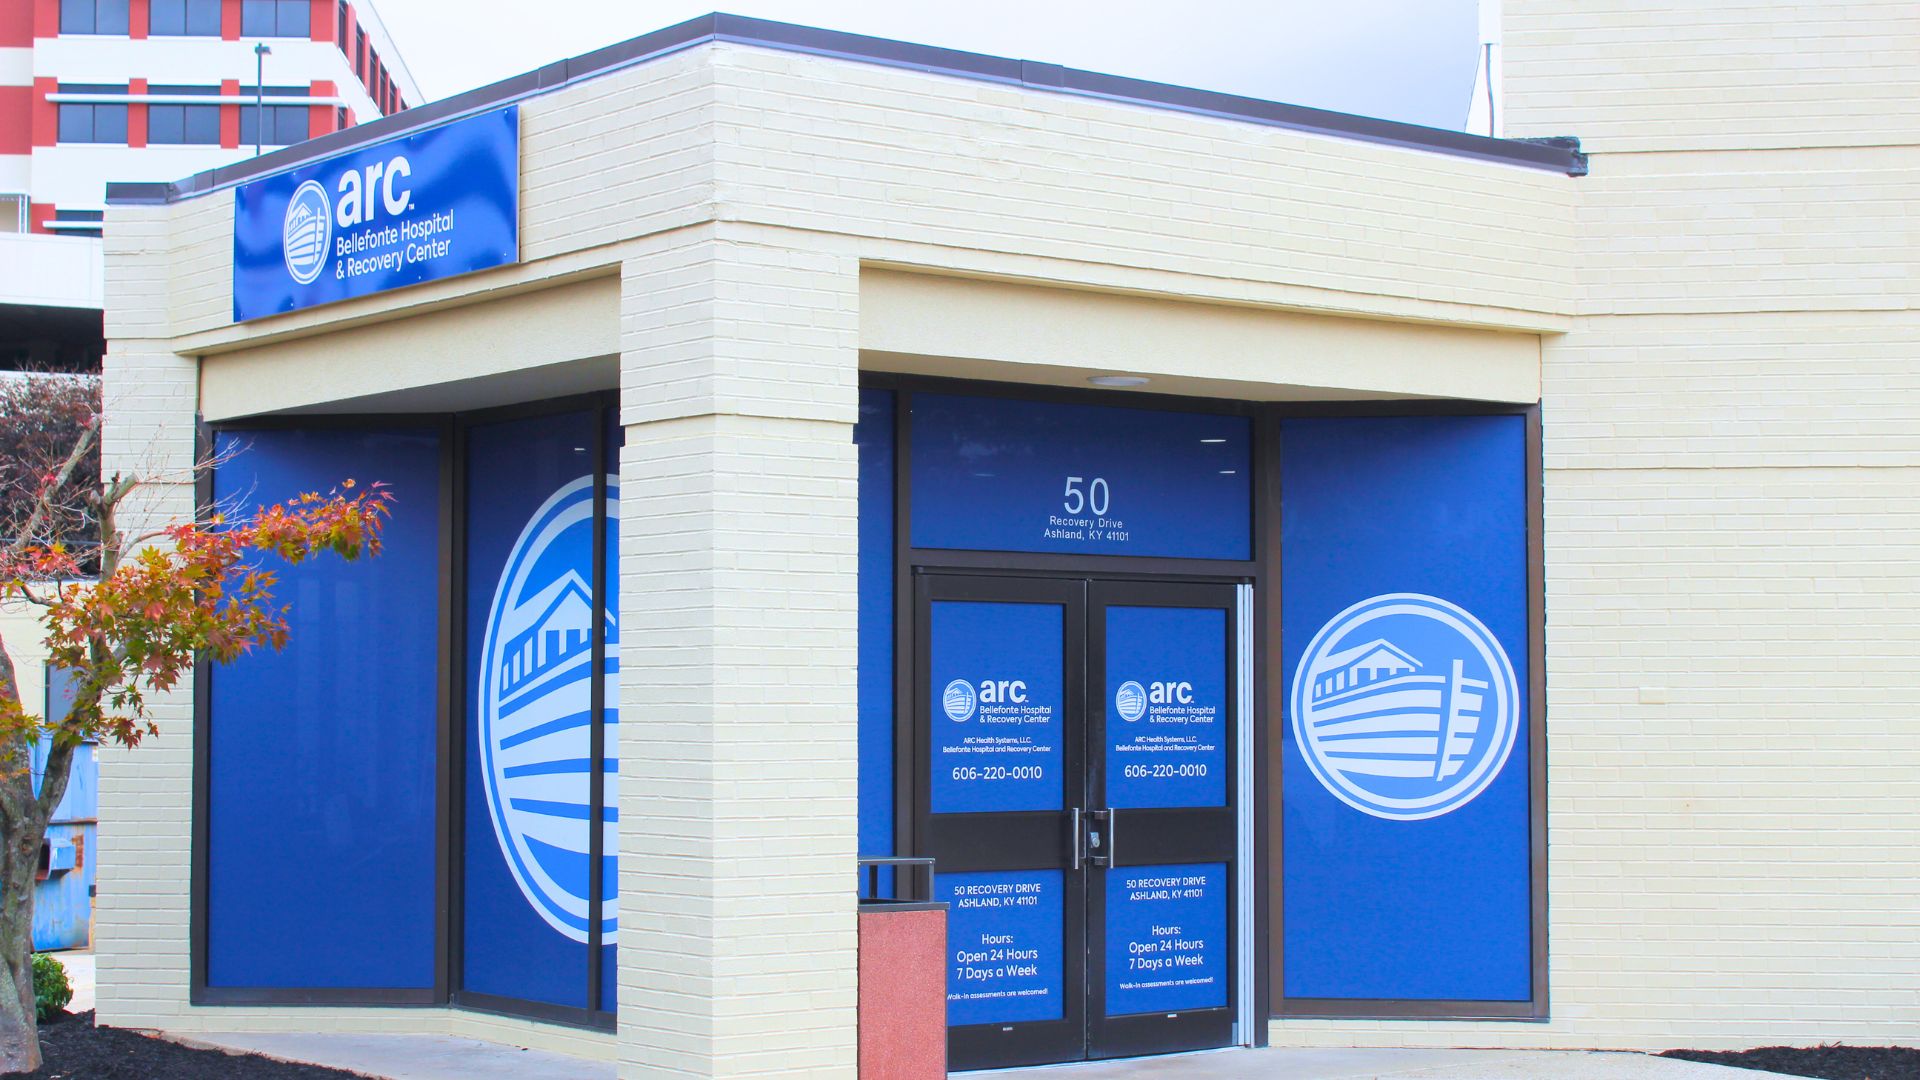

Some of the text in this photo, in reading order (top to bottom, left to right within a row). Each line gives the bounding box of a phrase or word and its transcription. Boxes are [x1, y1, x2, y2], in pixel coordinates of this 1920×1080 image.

[336, 156, 411, 228] arc
[336, 209, 454, 257] Bellefonte Hospital
[336, 239, 451, 280] & Recovery Center
[1064, 476, 1109, 516] 50
[1049, 515, 1123, 529] Recovery Drive
[1043, 528, 1129, 541] Ashland, KY 41101
[979, 680, 1027, 703] arc
[1149, 681, 1193, 704] arc
[979, 705, 1052, 716] Bellefonte Hospital
[1149, 705, 1216, 716] Bellefonte Hospital
[979, 714, 1051, 726] & Recovery Center
[1149, 714, 1214, 725] & Recovery Center
[995, 736, 1019, 745] Systems,
[1163, 736, 1186, 744] Systems,
[971, 746, 995, 754] Hospital
[1006, 745, 1032, 754] Recovery
[1142, 745, 1164, 753] Hospital
[1174, 744, 1198, 753] Recovery
[952, 766, 1043, 781] 606-220-0010
[1124, 763, 1207, 778] 606-220-0010
[1126, 876, 1206, 889] 50 RECOVERY DRIVE
[954, 883, 1042, 896] 50 RECOVERY DRIVE
[1130, 888, 1203, 901] ASHLAND, KY 41101
[958, 895, 1038, 909] ASHLAND, KY 41101
[1152, 925, 1182, 936] Hours:
[981, 933, 1014, 945] Hours:
[1129, 938, 1204, 956] Open 24 Hours
[956, 948, 1038, 965] Open 24 Hours
[1129, 954, 1204, 971] 7 Days a Week
[956, 963, 1038, 982] 7 Days a Week
[1141, 979, 1175, 988] assessments
[970, 990, 1006, 999] assessments
[1017, 987, 1049, 996] welcomed!
